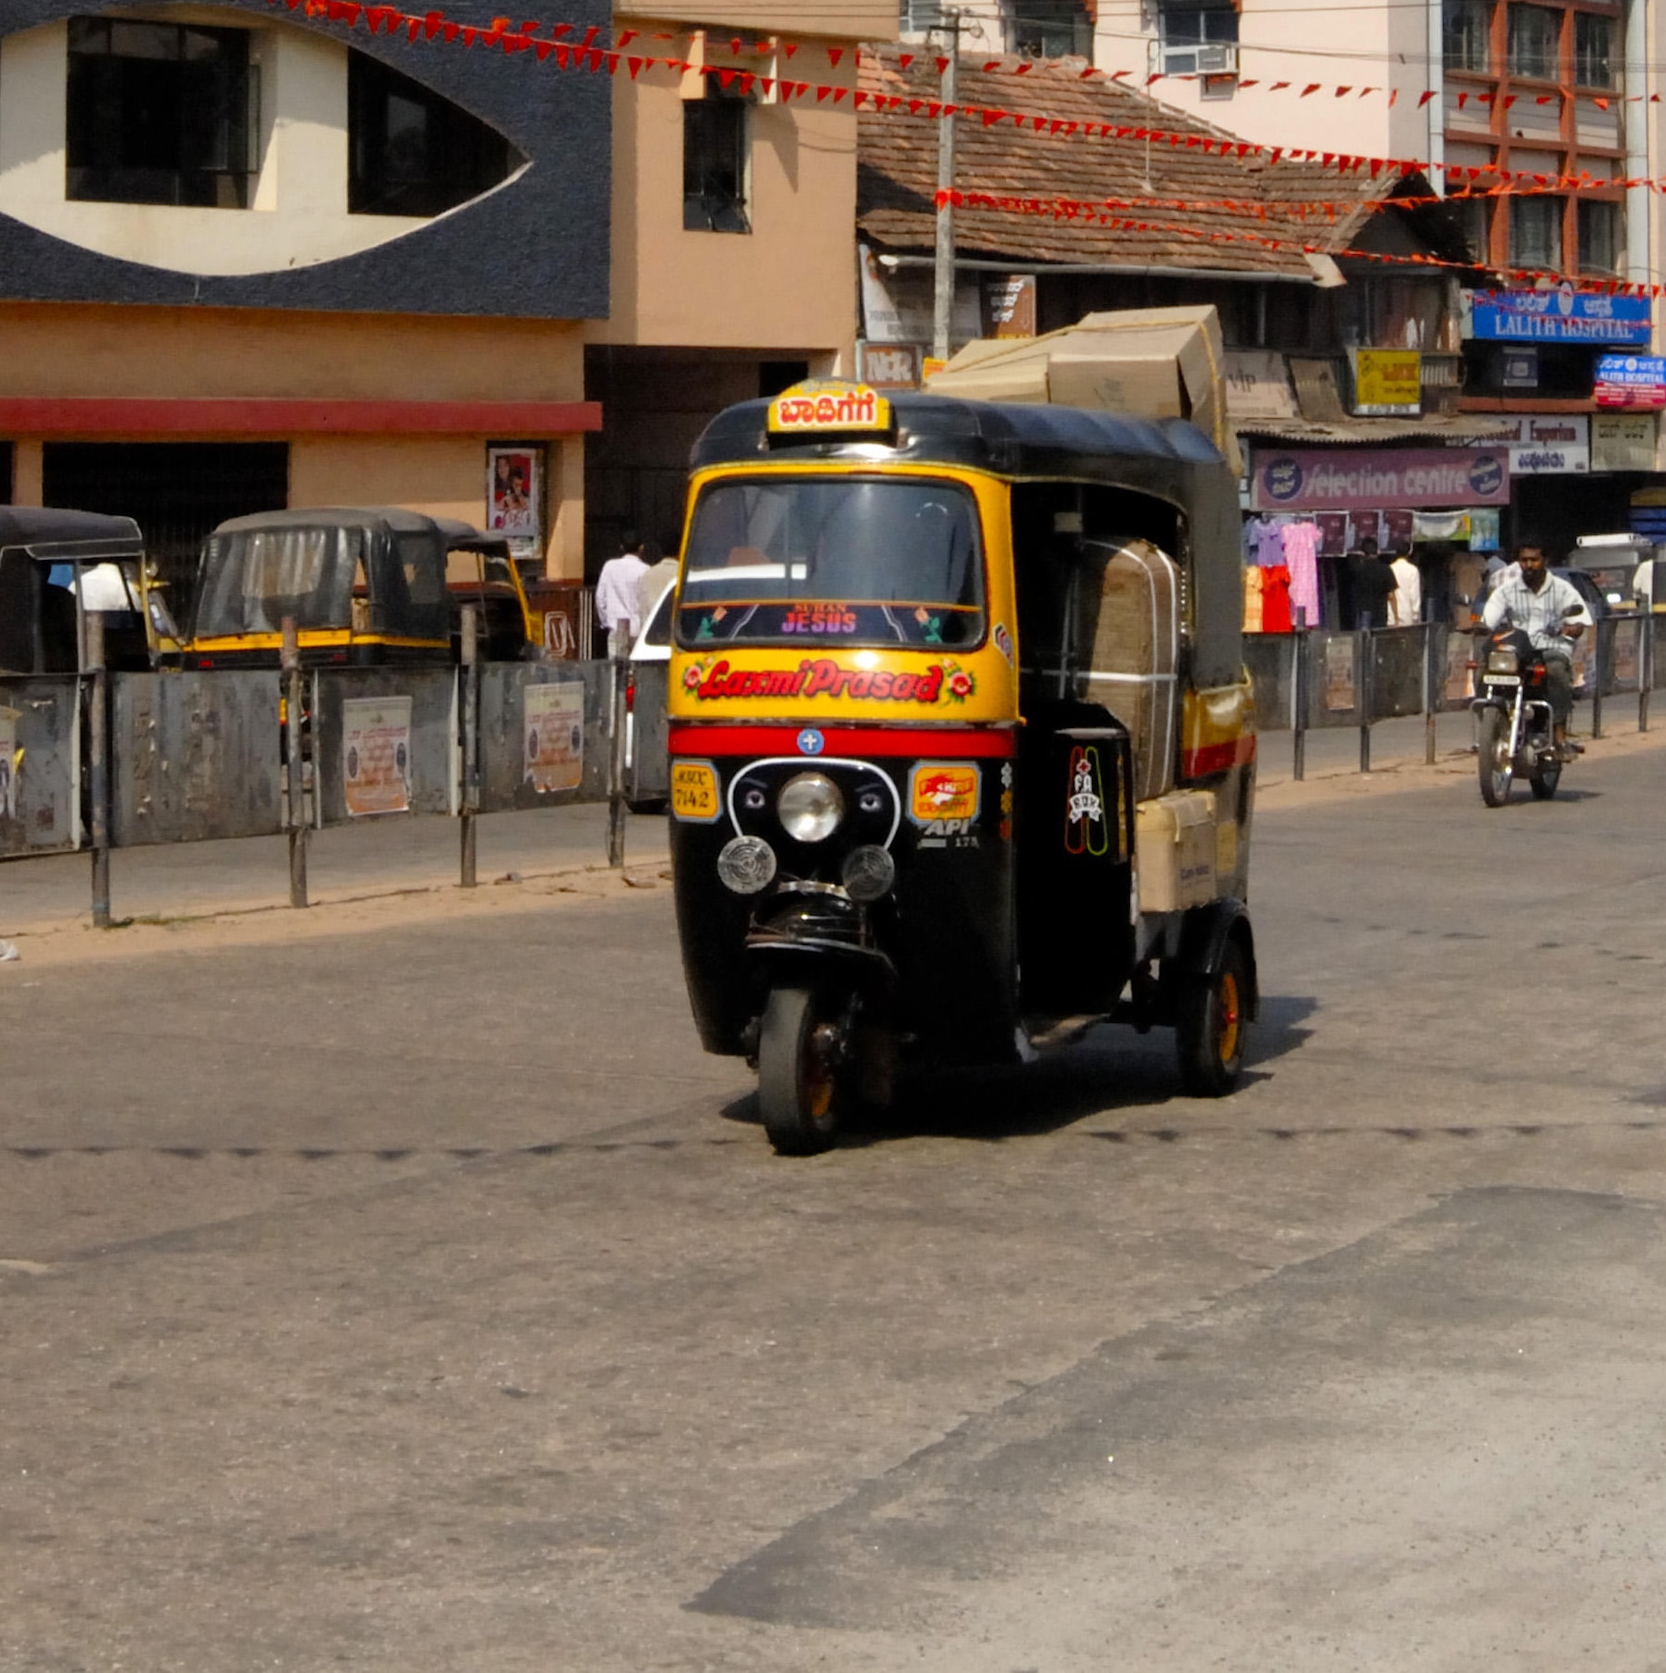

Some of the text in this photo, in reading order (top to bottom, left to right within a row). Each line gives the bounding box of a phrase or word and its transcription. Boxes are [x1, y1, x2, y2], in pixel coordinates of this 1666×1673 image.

[1495, 314, 1634, 338] LALITH HOSPITAL
[779, 391, 875, 424] ಬಾಡಿಗೆಗೆ
[781, 612, 857, 634] JESUS
[697, 660, 943, 703] Laxmi Prasad
